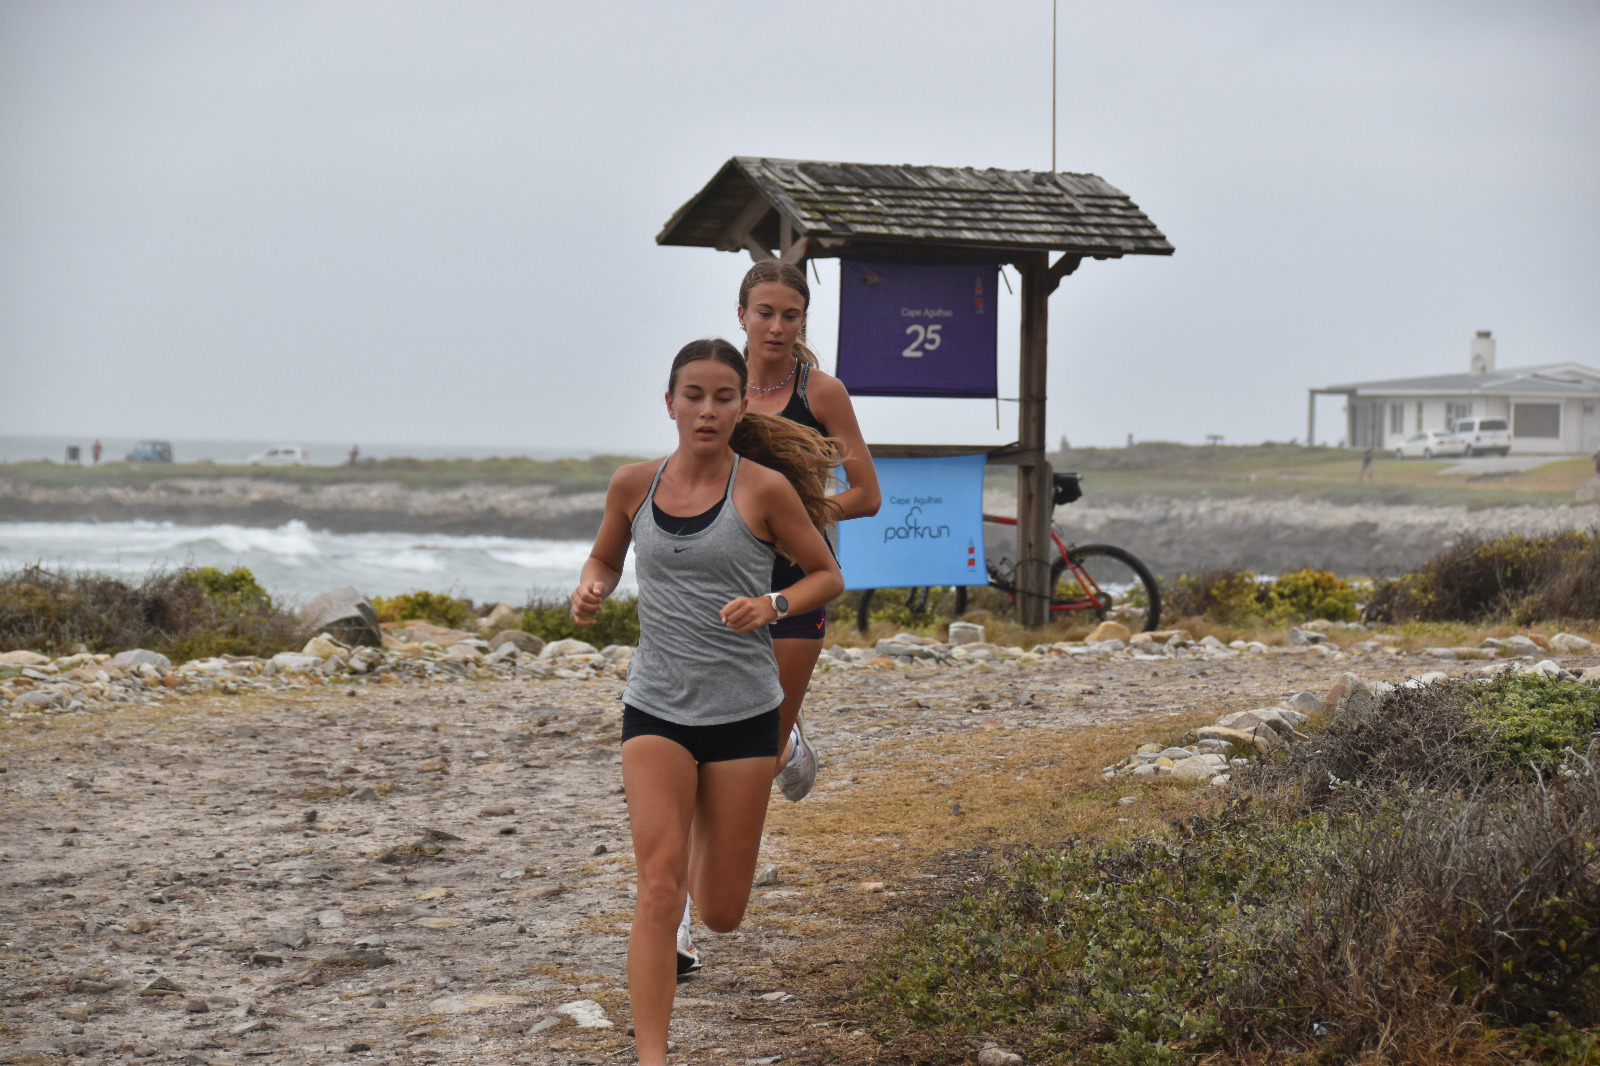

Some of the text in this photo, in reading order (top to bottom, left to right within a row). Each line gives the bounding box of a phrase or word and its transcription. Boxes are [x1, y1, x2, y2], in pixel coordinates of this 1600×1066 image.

[901, 307, 953, 319] Cape Agulhas
[902, 324, 942, 358] 25
[889, 495, 943, 506] Cape Agulhas
[883, 517, 950, 543] parkrun
